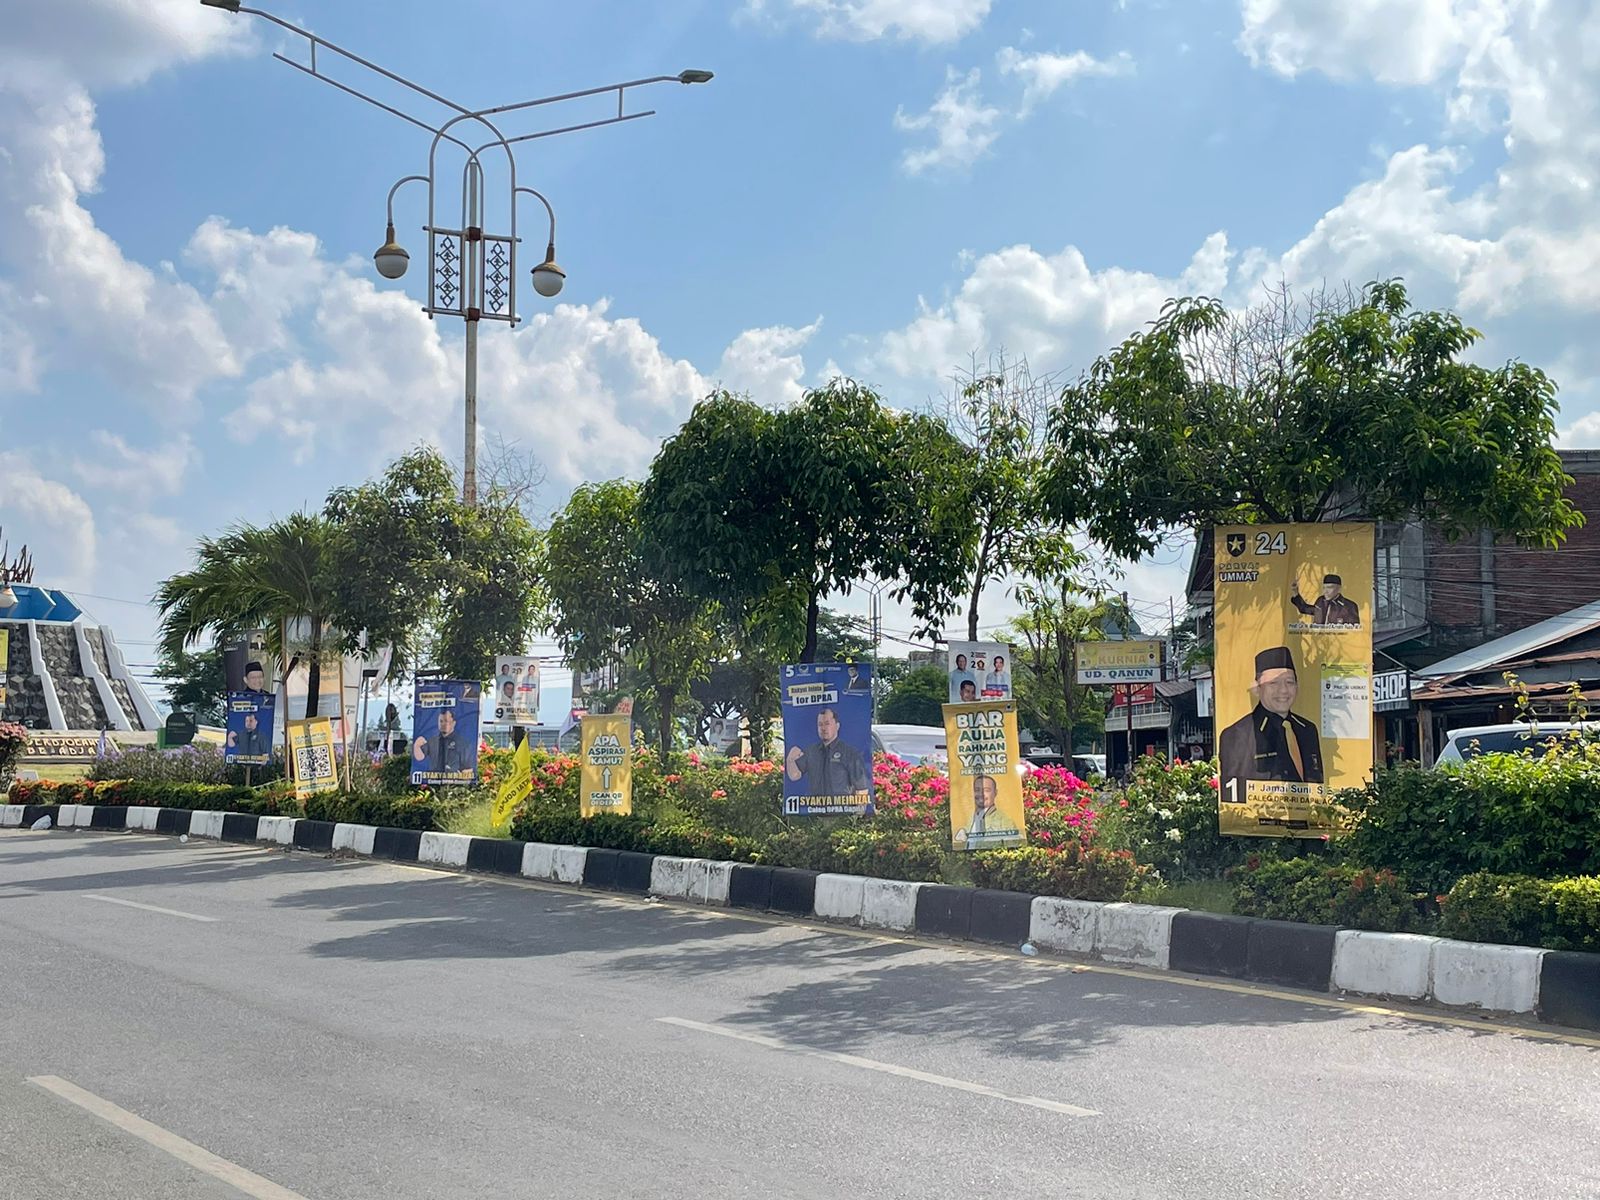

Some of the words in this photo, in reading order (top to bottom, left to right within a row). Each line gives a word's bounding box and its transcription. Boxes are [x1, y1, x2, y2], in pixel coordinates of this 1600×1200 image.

[1255, 531, 1287, 554] 24
[1219, 571, 1259, 582] UMMAT
[1099, 655, 1146, 664] KURNIA
[785, 665, 795, 677] 5
[1109, 669, 1153, 679] QANUN
[1373, 674, 1407, 701] SHOP
[495, 707, 504, 718] 9
[956, 710, 1004, 728] BIAR
[593, 735, 619, 746] APA
[960, 729, 1005, 742] AULIA
[588, 747, 626, 755] ASPIRASI
[959, 742, 1005, 752] RAHMAN
[591, 756, 623, 765] KAMU?
[958, 753, 1007, 767] YANG
[413, 773, 421, 783] 11
[1226, 778, 1238, 802] 1
[800, 796, 832, 806] SYAKYA
[1248, 795, 1272, 803] CALEG
[788, 798, 798, 812] 11
